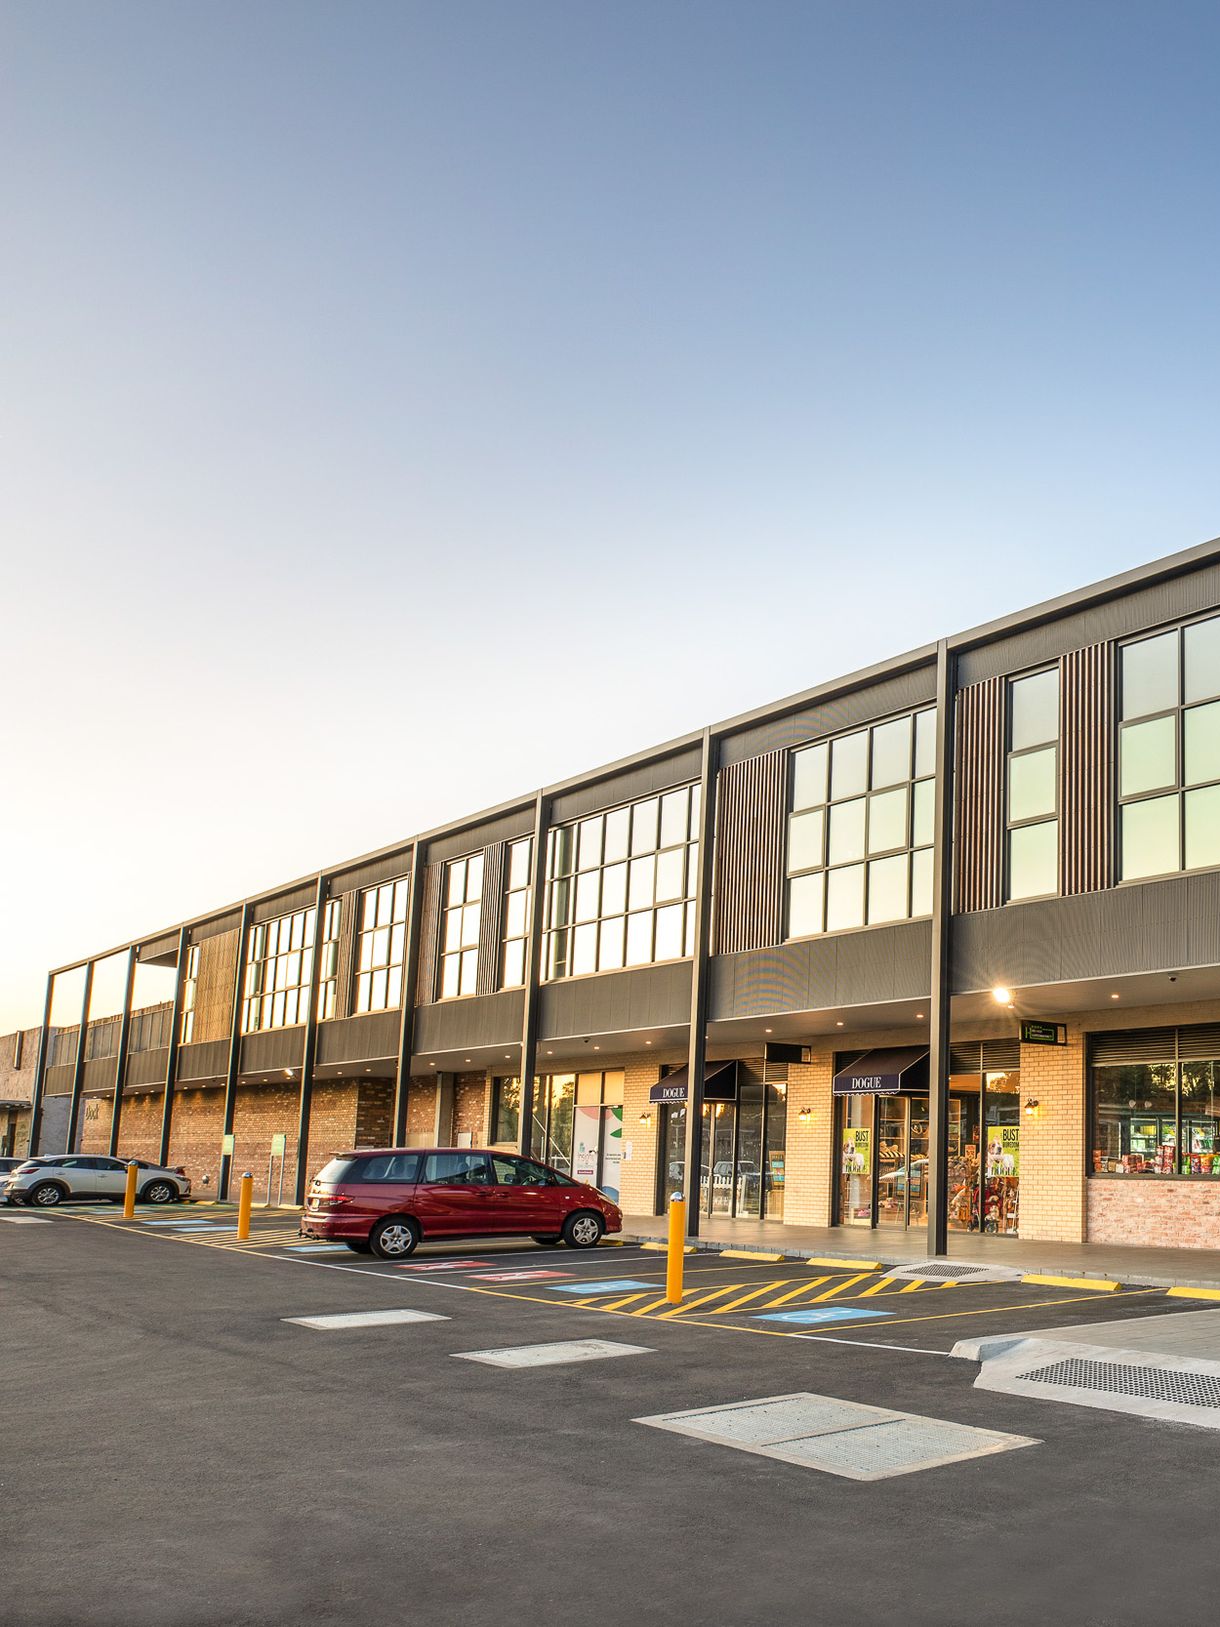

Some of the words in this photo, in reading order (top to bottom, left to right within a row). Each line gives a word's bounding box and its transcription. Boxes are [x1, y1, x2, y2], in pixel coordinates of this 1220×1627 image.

[852, 1077, 881, 1089] DOGUE
[663, 1088, 685, 1098] DOGUE
[855, 1130, 869, 1142] BUST
[1002, 1129, 1019, 1141] BUST
